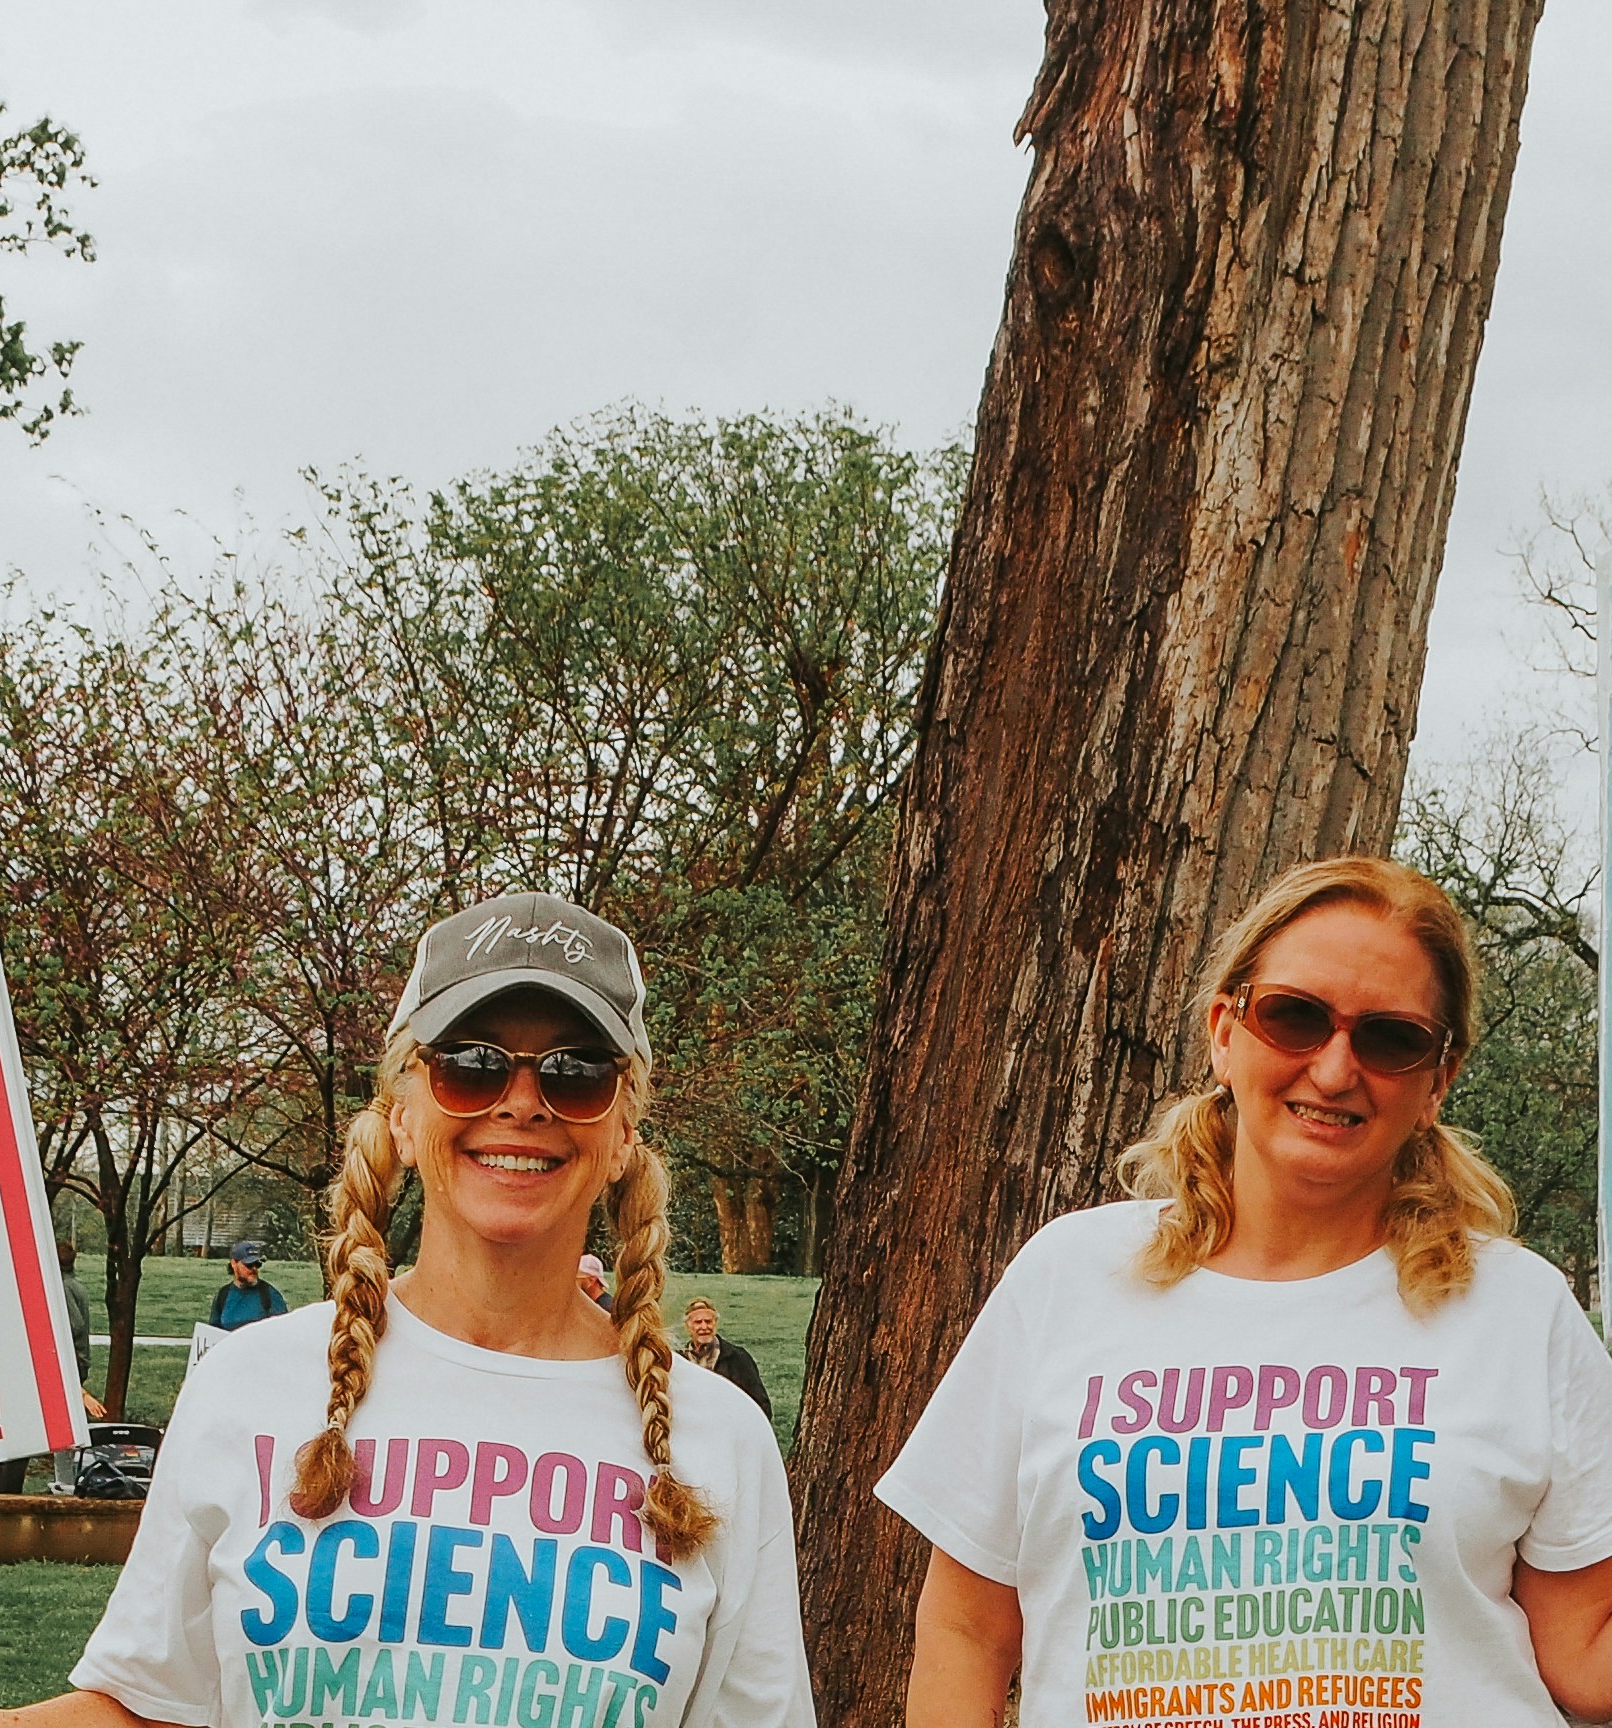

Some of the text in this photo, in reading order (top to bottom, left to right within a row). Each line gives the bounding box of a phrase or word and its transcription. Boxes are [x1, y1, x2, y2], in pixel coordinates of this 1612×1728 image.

[1078, 1364, 1439, 1439] I SUPPORT
[254, 1435, 275, 1529] I
[1078, 1429, 1435, 1541] SCIENCE
[1081, 1524, 1421, 1600] HUMAN RIGHTS
[241, 1521, 682, 1685] SCIENCE
[1087, 1587, 1425, 1650] PUBLIC EDUCATION
[246, 1647, 446, 1722] HUMAN
[1086, 1635, 1423, 1688] AFFORDABLE HEALTH CARE
[1087, 1675, 1422, 1722] IMMIGRANTS AND REFUGEES
